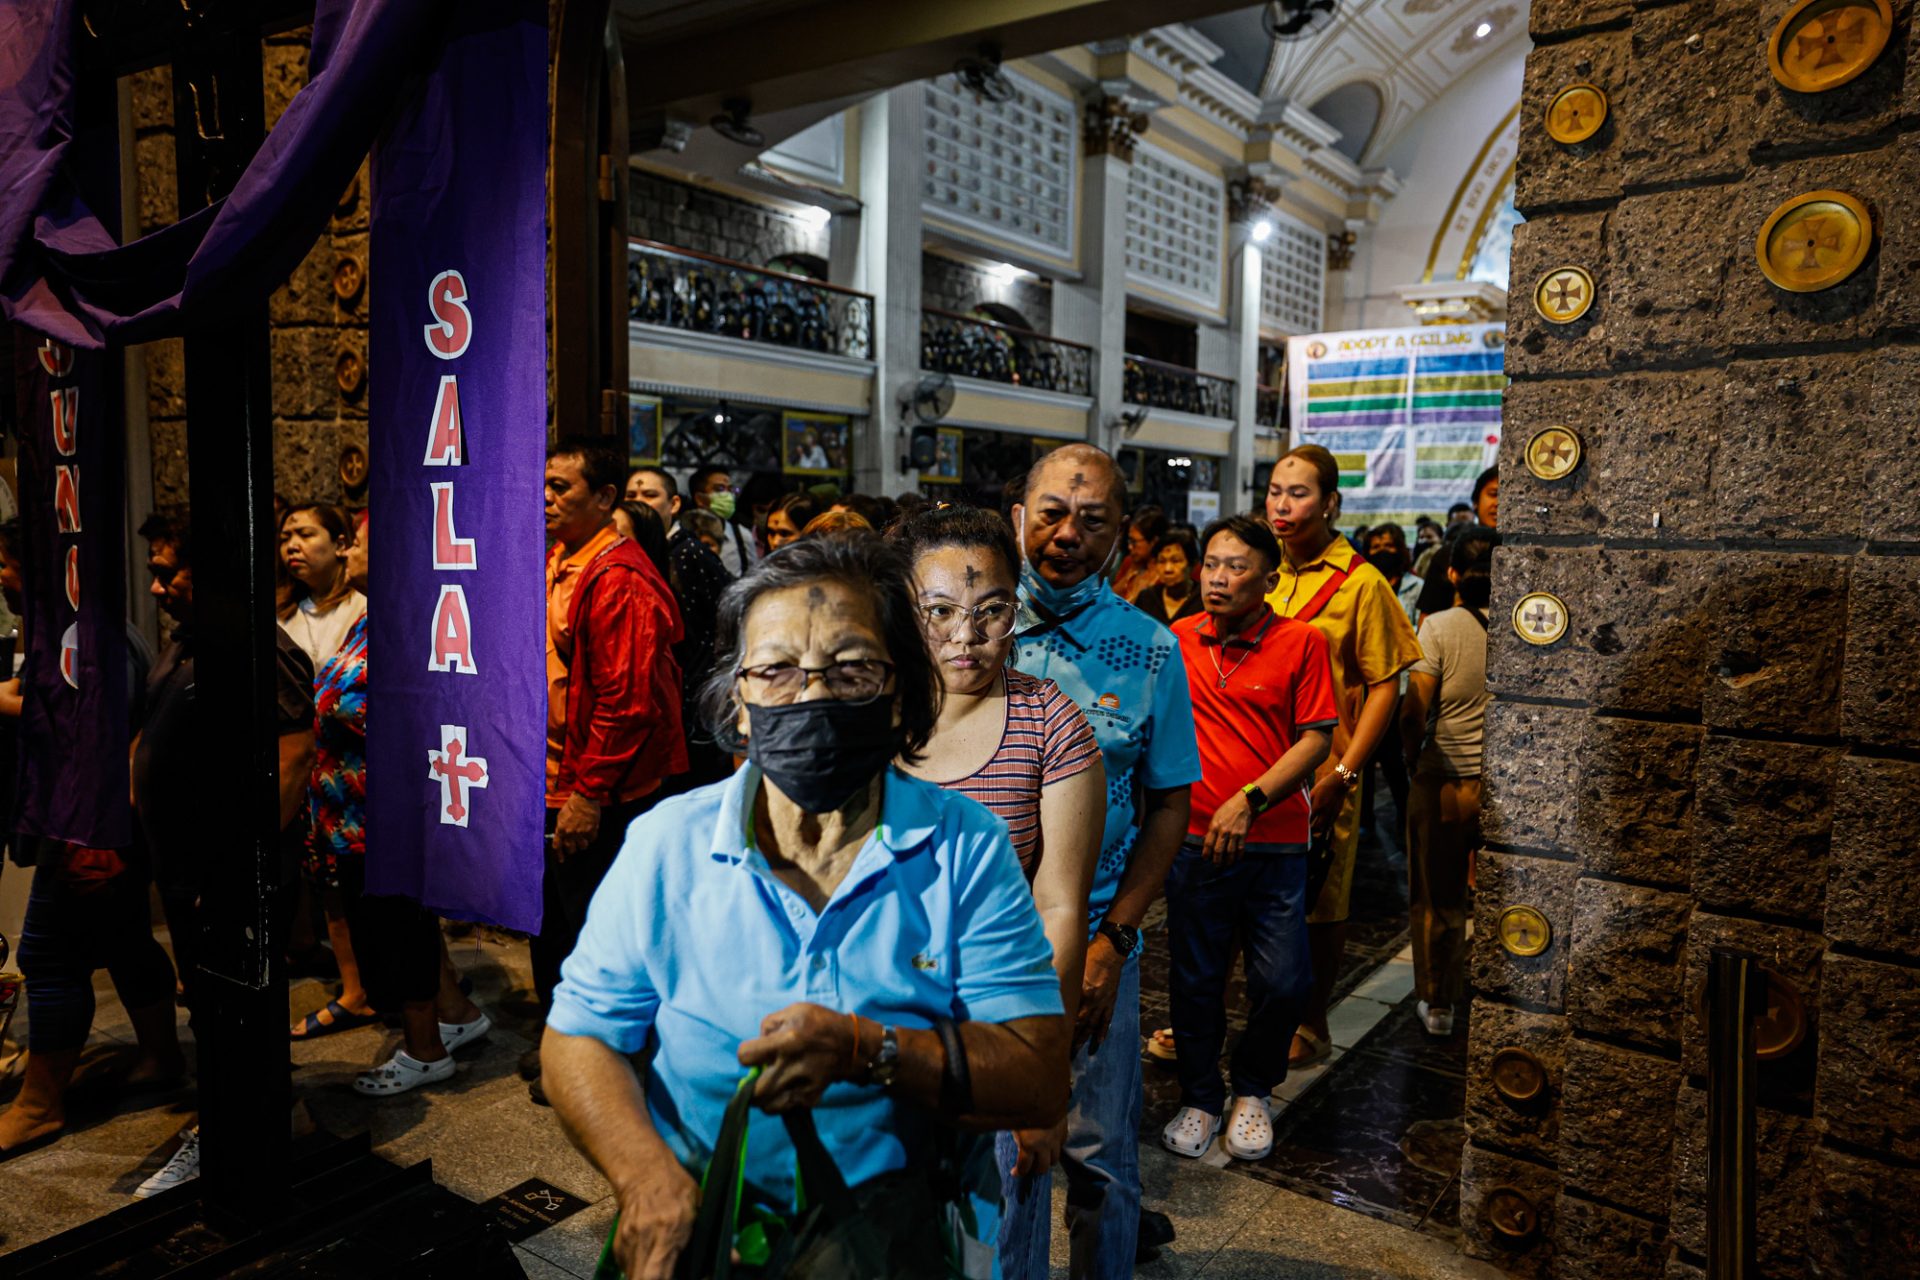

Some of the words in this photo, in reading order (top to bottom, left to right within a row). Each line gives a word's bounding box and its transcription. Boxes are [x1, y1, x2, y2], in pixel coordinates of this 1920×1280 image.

[1338, 335, 1389, 351] ADOPT
[1395, 335, 1406, 347] A
[423, 269, 478, 675] SALA
